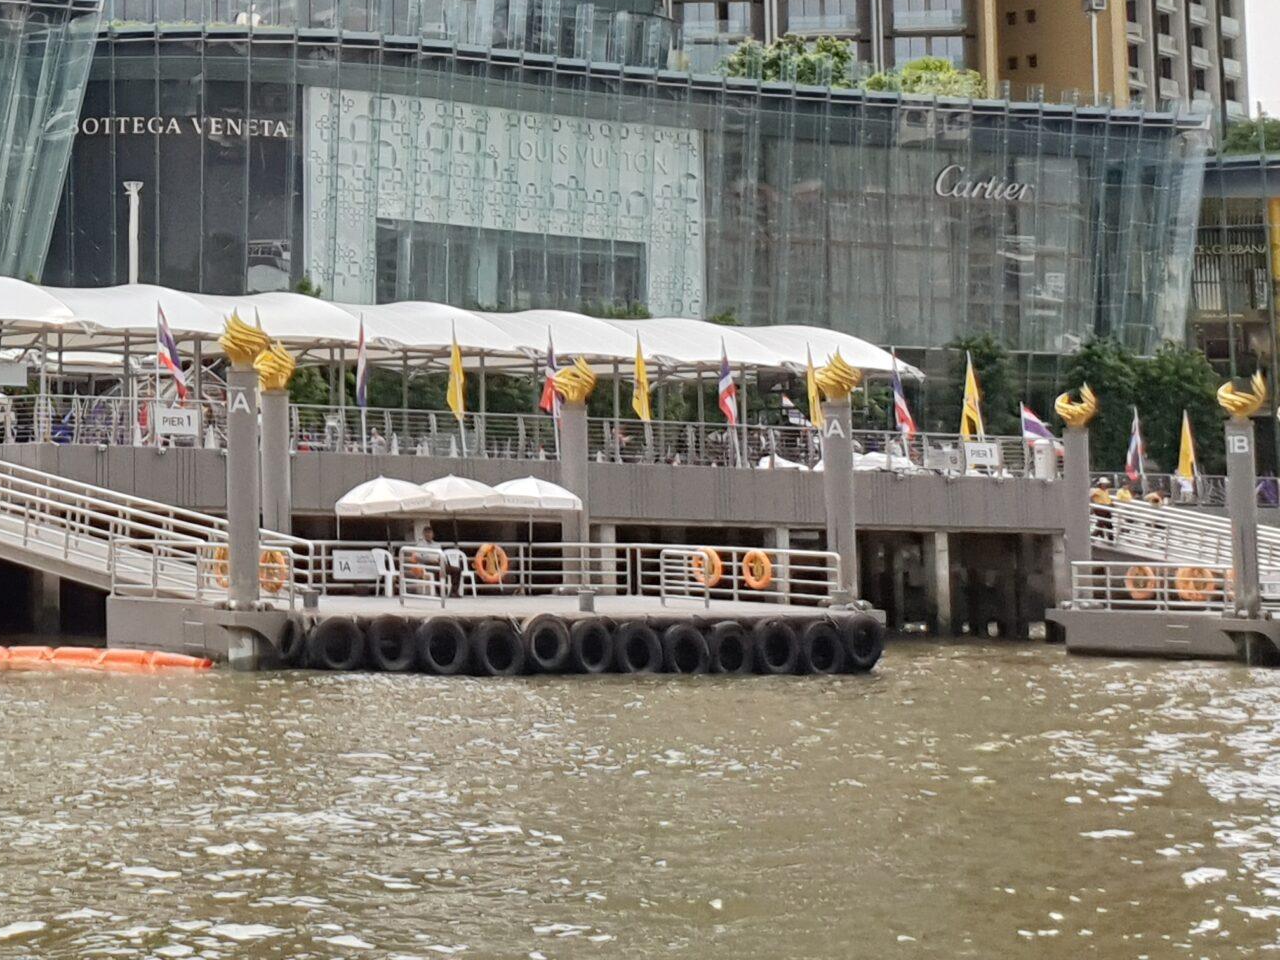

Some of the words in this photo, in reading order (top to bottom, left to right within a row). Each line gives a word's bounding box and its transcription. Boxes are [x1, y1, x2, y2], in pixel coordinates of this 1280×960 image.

[191, 117, 288, 138] VENETA
[935, 164, 1034, 200] Cartier
[162, 416, 184, 426] PIER
[186, 415, 192, 427] 1
[1227, 435, 1249, 453] 1B
[338, 561, 351, 572] 1A
